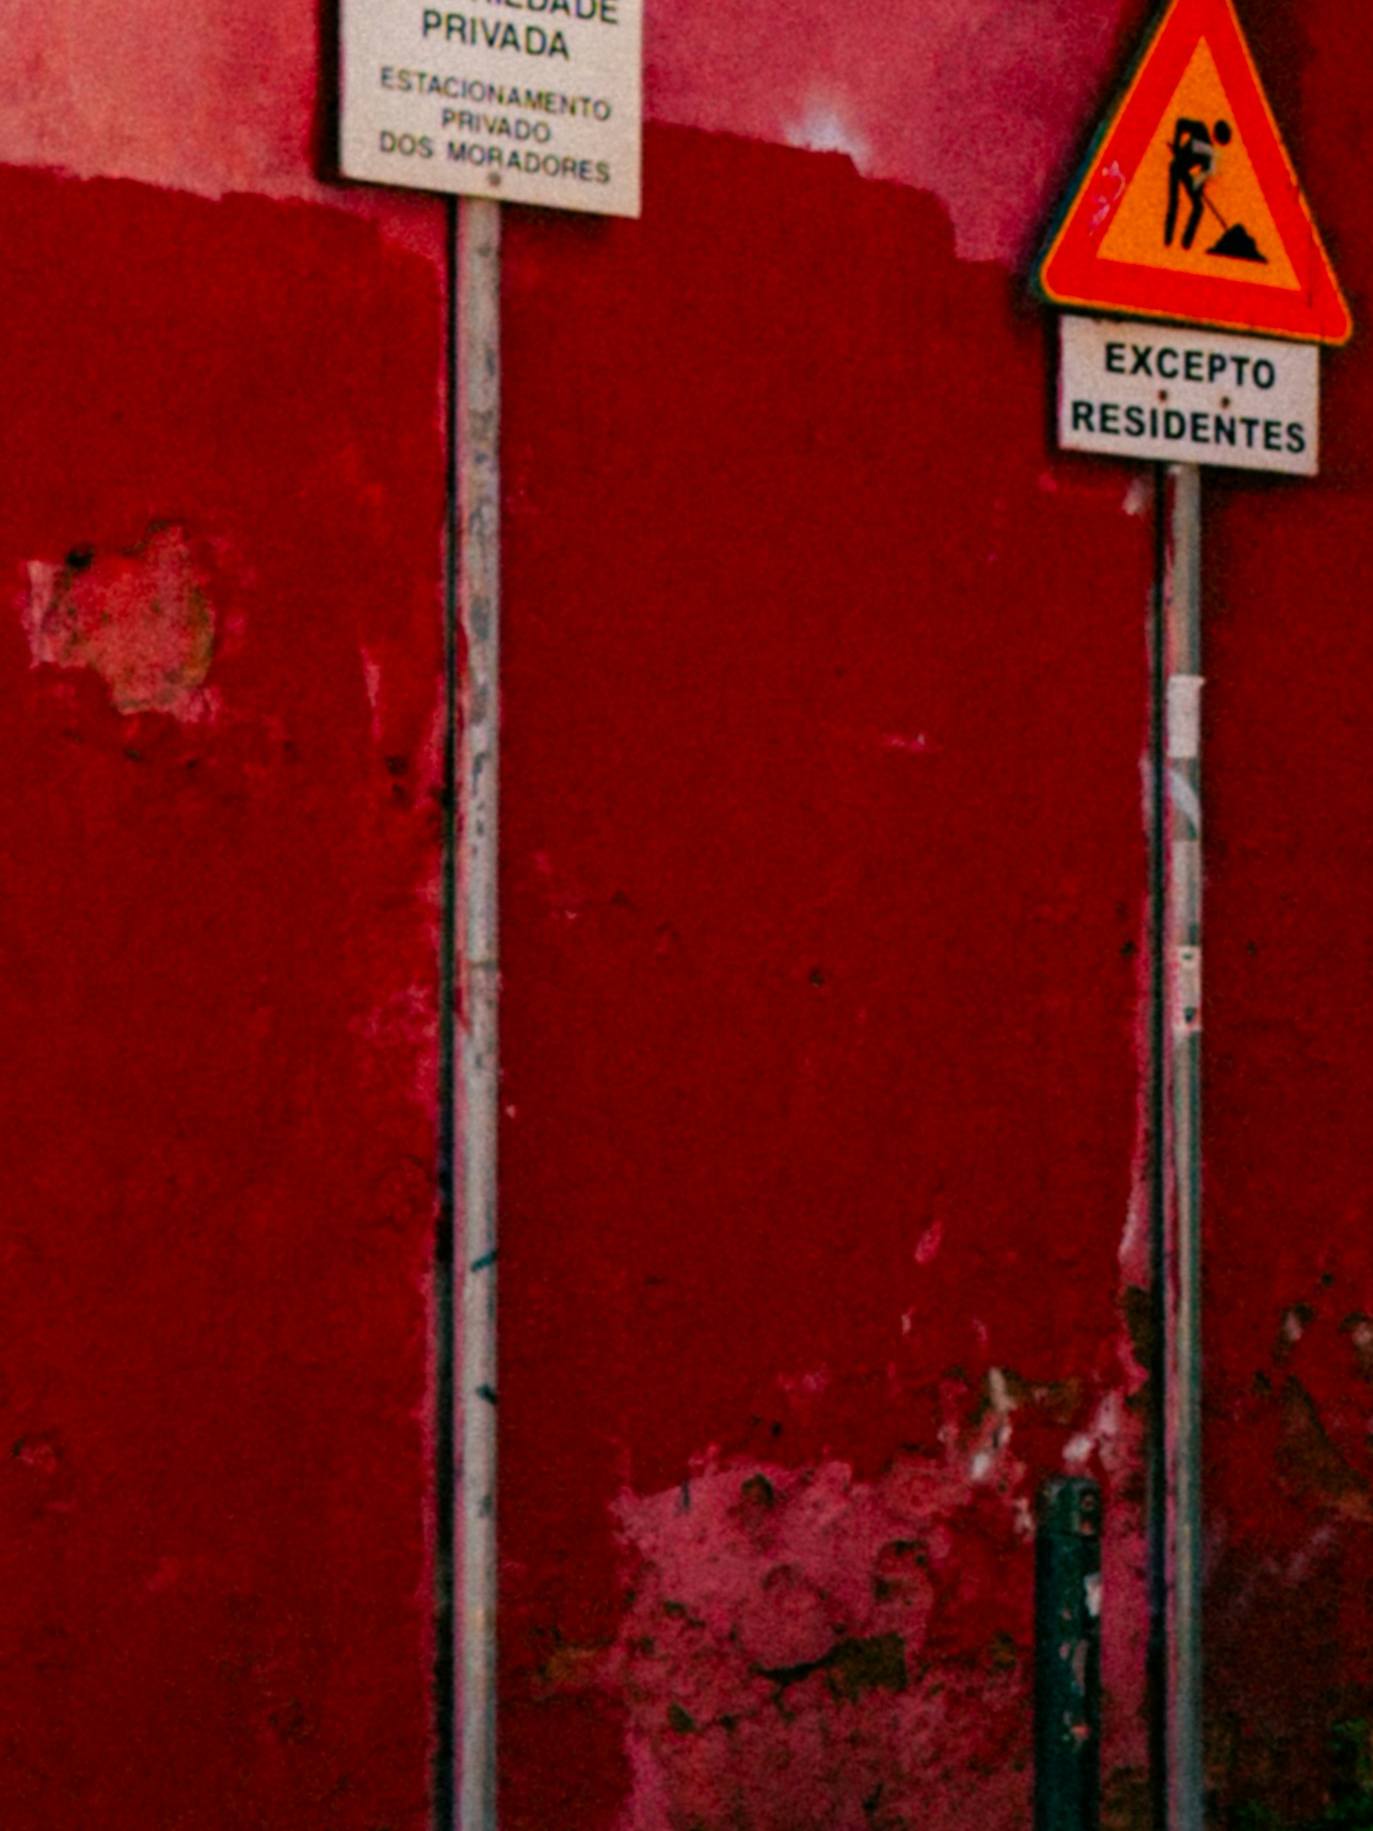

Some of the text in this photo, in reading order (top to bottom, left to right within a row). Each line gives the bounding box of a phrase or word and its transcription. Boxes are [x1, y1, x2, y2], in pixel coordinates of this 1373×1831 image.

[422, 9, 570, 61] PRIVADA
[380, 66, 612, 121] ESTACIONAMENTO
[441, 107, 552, 144] PRIVADO
[379, 131, 611, 185] DOS MORADORES
[1105, 342, 1276, 390] EXCEPTO
[1071, 401, 1306, 454] RESIDENTES
